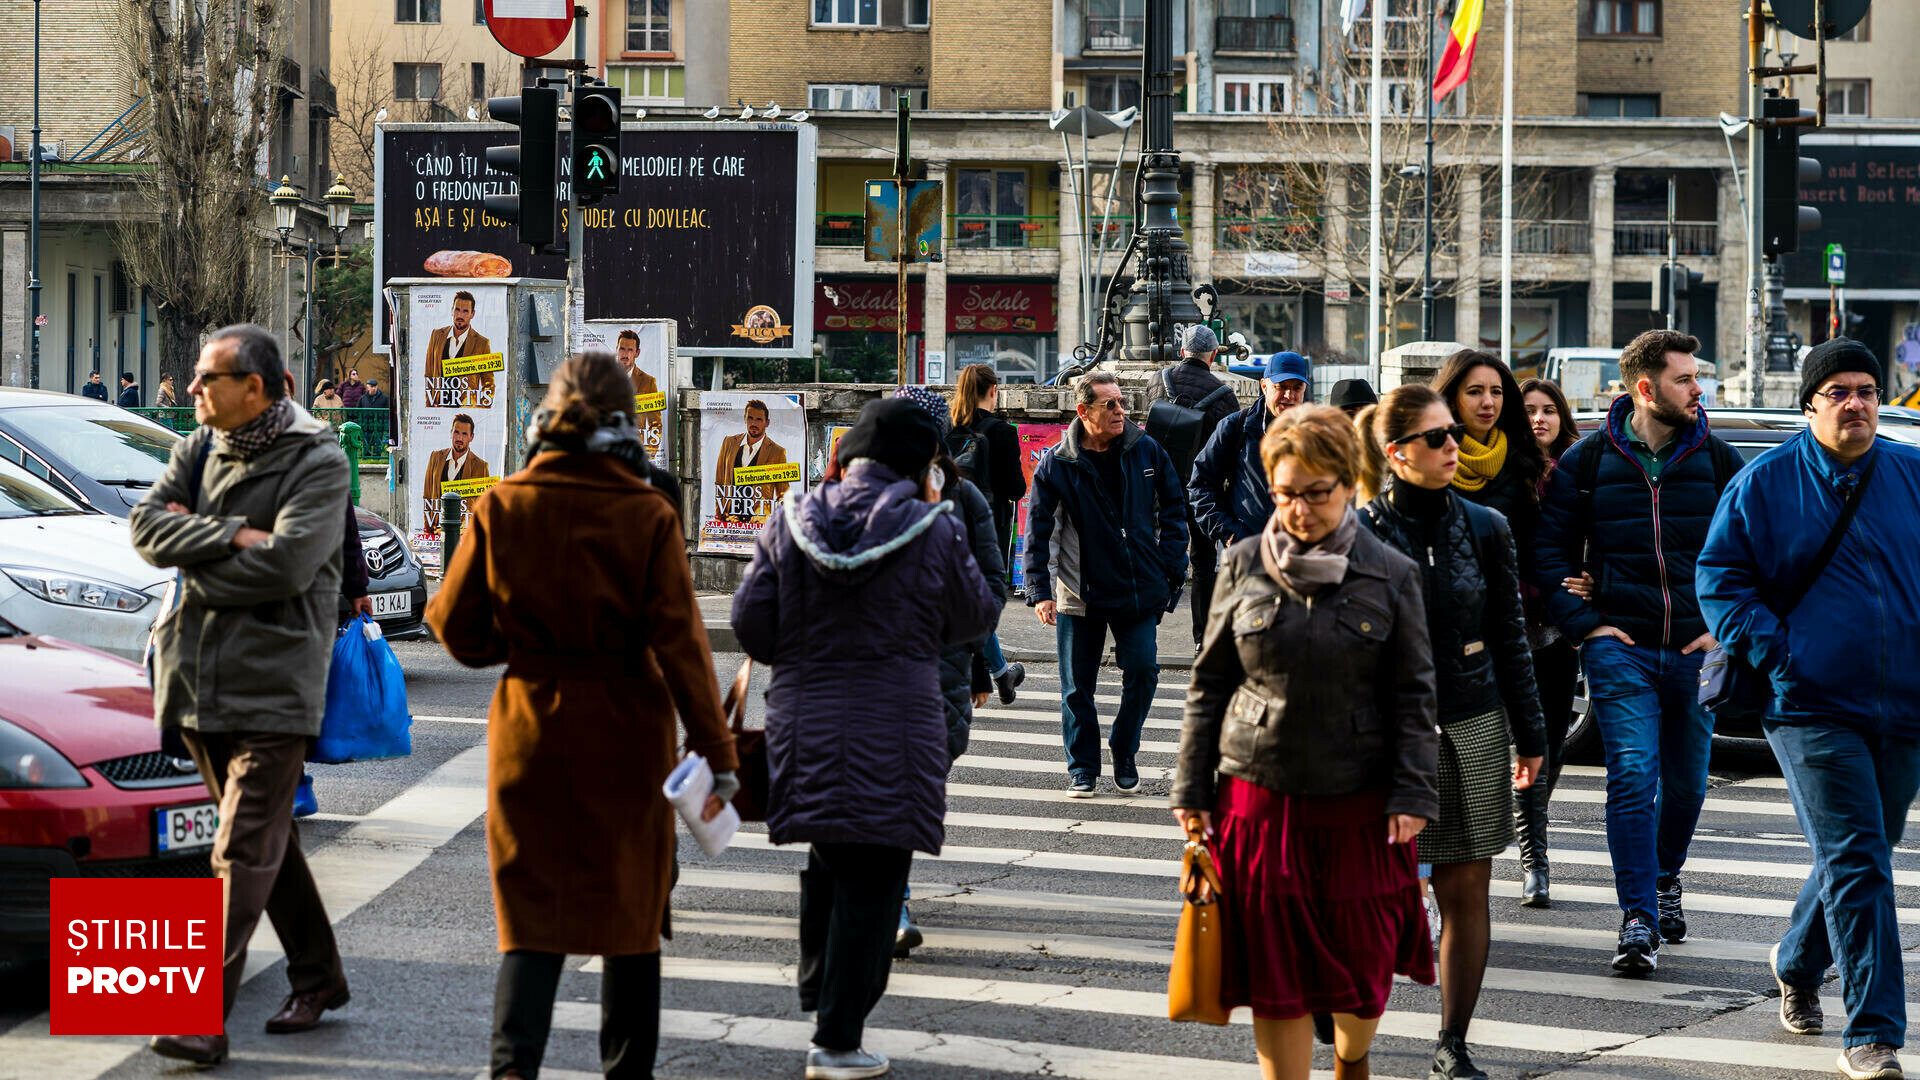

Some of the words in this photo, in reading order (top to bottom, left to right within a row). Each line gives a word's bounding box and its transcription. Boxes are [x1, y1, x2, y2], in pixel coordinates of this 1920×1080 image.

[416, 152, 453, 176] CÂND
[458, 152, 478, 179] ÎȚI
[622, 156, 682, 177] MELODIEI
[689, 157, 705, 177] PE
[713, 156, 745, 177] CARE
[1828, 161, 1857, 179] and
[416, 180, 425, 200] O
[433, 181, 503, 201] FREDONEZI
[1799, 186, 1847, 202] nsert
[1857, 185, 1896, 202] Boot
[415, 207, 440, 232] AȘA
[448, 208, 455, 227] E
[463, 208, 475, 233] ȘI
[561, 208, 616, 233] ȘUDEL
[624, 208, 641, 228] CU
[648, 208, 711, 229] DOVLEAC.
[962, 284, 1031, 312] Selale
[747, 328, 776, 337] LUCA
[445, 367, 452, 375] 26
[425, 377, 469, 390] NIKOS
[425, 389, 494, 407] VERTIS
[737, 475, 744, 483] 26
[783, 471, 799, 479] 19:30
[715, 484, 763, 499] NIKOS
[424, 498, 468, 512] NIS
[715, 499, 784, 516] VERTI
[705, 521, 725, 529] SALA
[375, 596, 385, 613] 13
[389, 593, 408, 612] KAJ
[173, 812, 187, 842] B
[194, 808, 215, 840] 63
